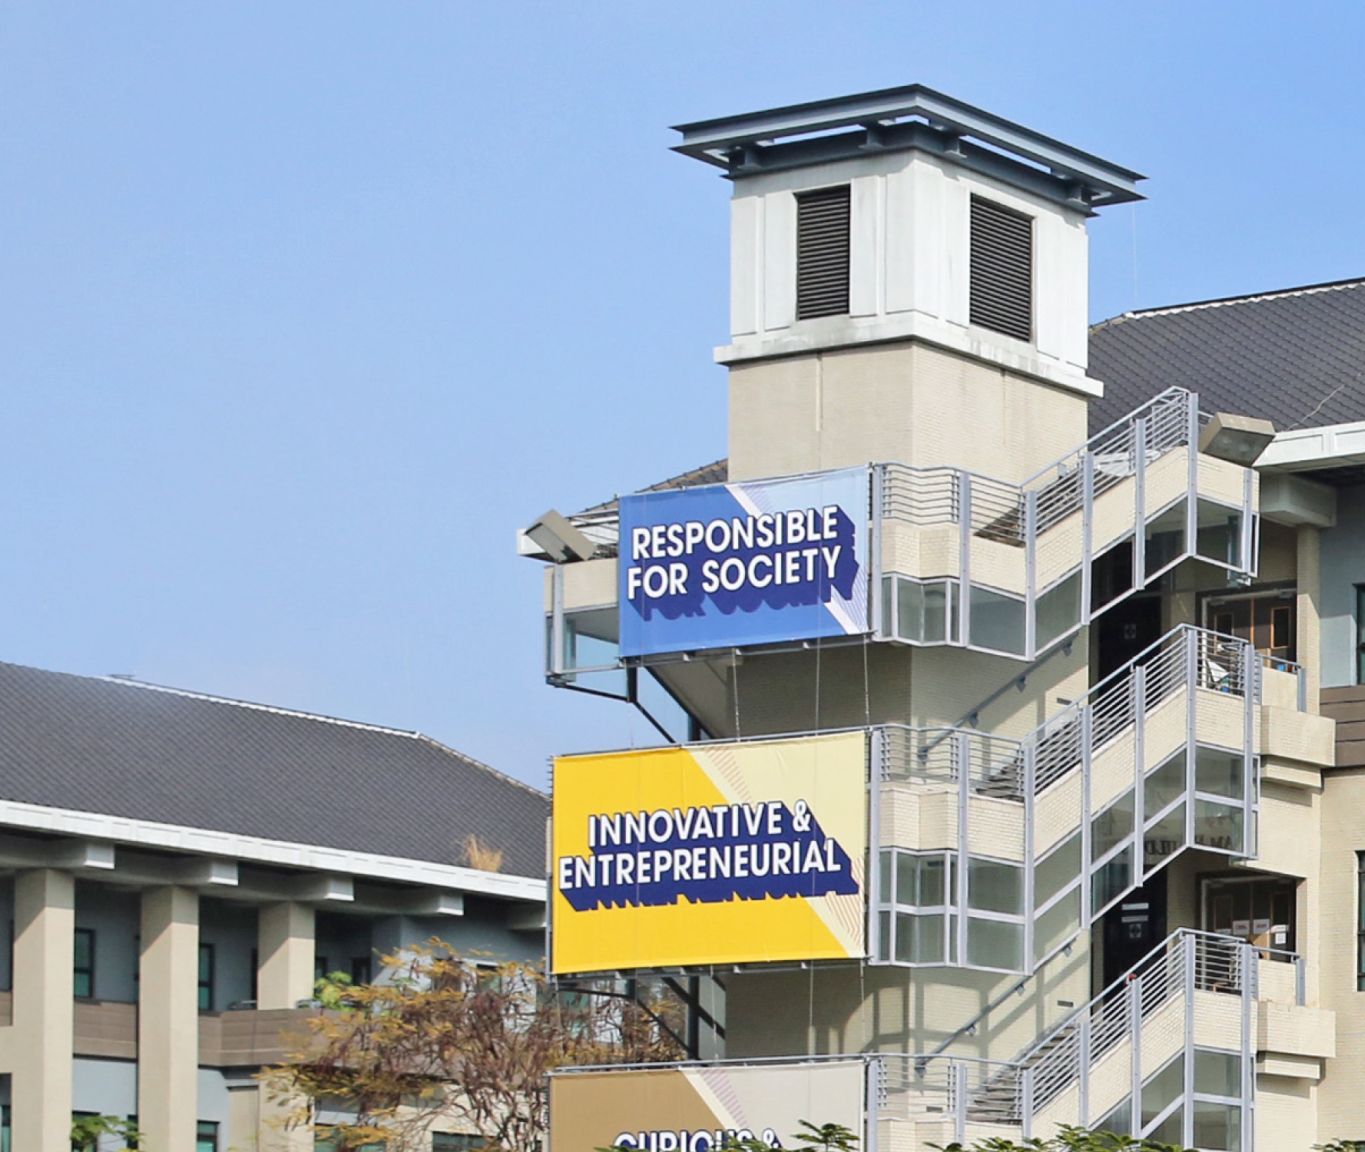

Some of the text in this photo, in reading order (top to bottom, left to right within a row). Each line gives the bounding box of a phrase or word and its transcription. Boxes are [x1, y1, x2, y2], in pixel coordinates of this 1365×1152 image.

[632, 505, 838, 560] RESPONSIBLE
[627, 546, 841, 600] FOR SOCIETY
[588, 799, 812, 848] INNOVATIVE &
[559, 838, 841, 890] ENTREPRENEURIAL
